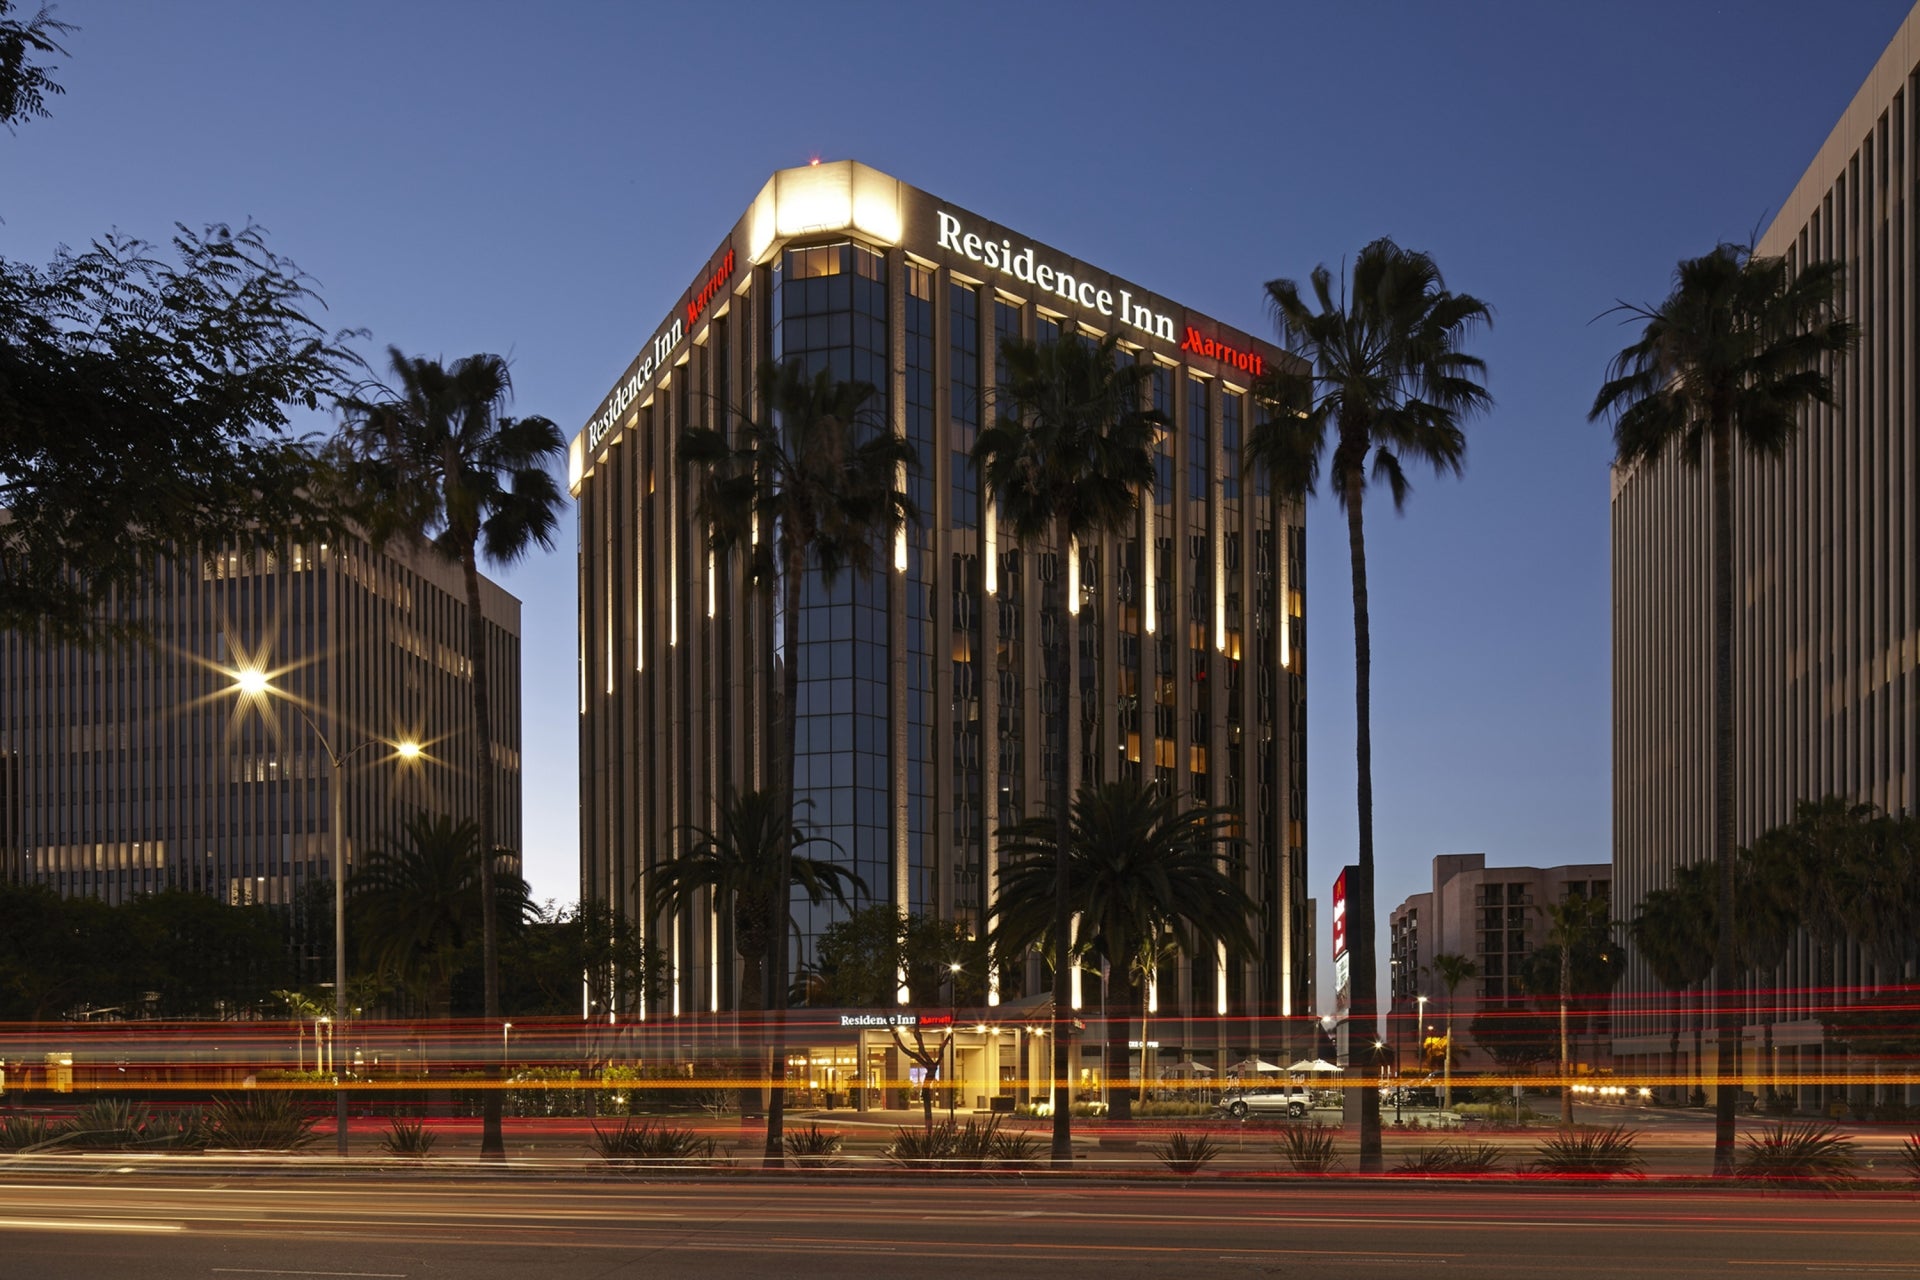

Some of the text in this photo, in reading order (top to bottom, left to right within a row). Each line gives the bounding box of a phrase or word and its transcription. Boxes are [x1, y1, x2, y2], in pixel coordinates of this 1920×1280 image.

[588, 248, 735, 454] Residence Inn Marriott
[936, 210, 1263, 376] Residence Inn Marriott
[896, 1014, 916, 1025] Inn
